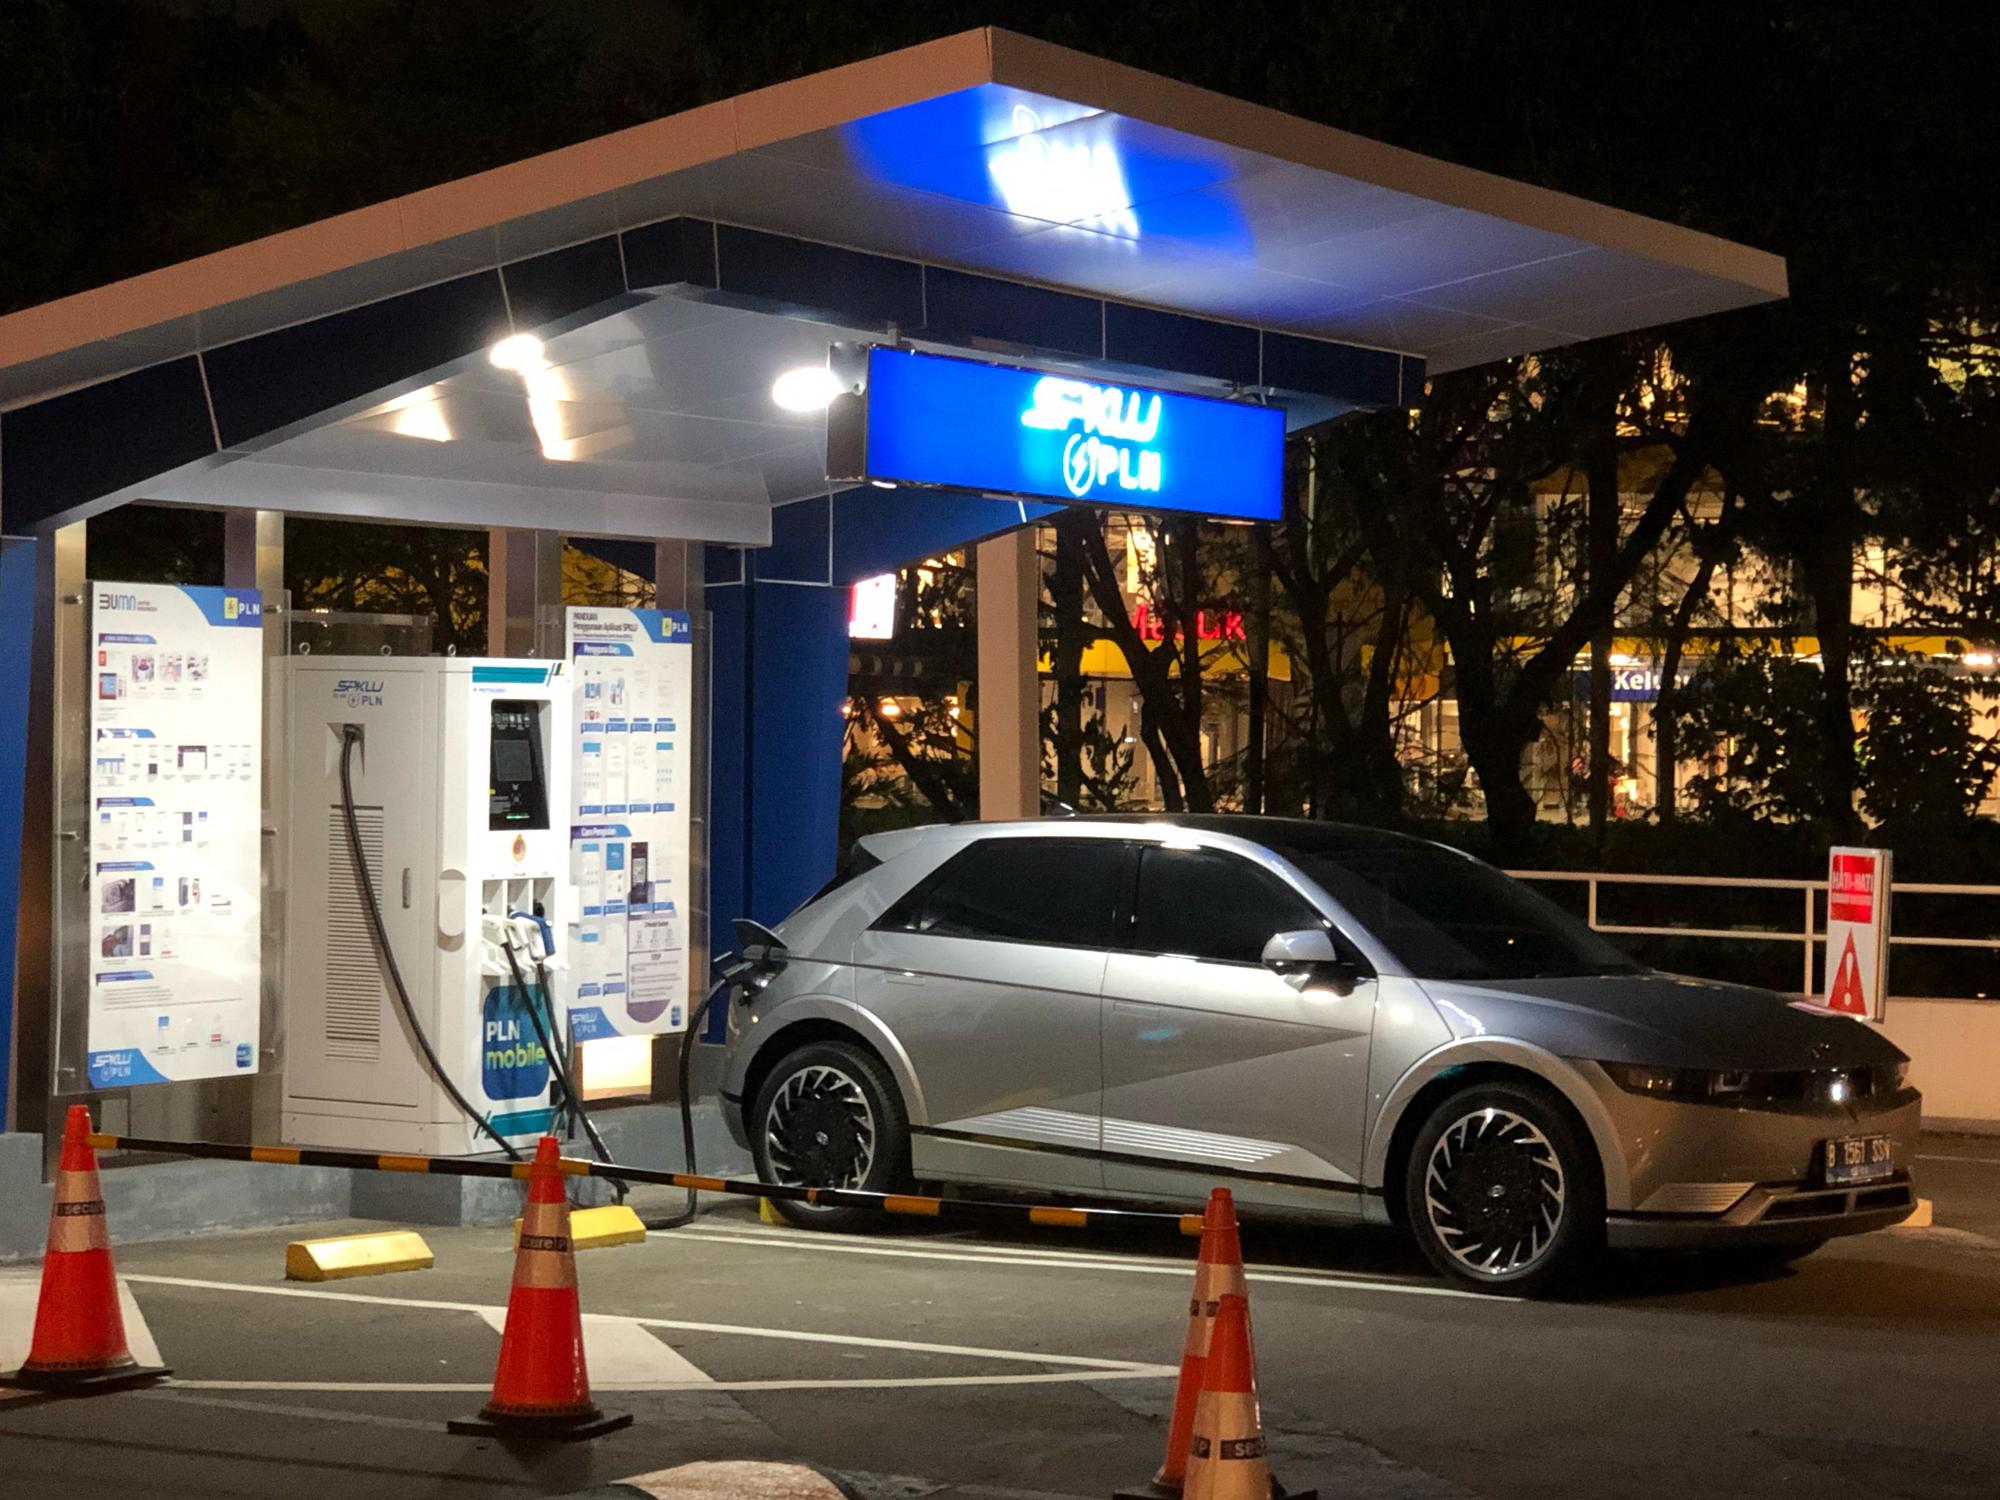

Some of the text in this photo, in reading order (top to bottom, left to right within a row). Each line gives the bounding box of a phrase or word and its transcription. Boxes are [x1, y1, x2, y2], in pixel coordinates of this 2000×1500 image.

[1098, 444, 1161, 491] PLN
[238, 602, 260, 616] PLN
[671, 622, 688, 633] PLN
[333, 680, 384, 692] SPKLU
[361, 695, 383, 706] PLN
[486, 1020, 520, 1042] PLN
[486, 1041, 546, 1070] mobile
[1827, 1143, 1836, 1168] B
